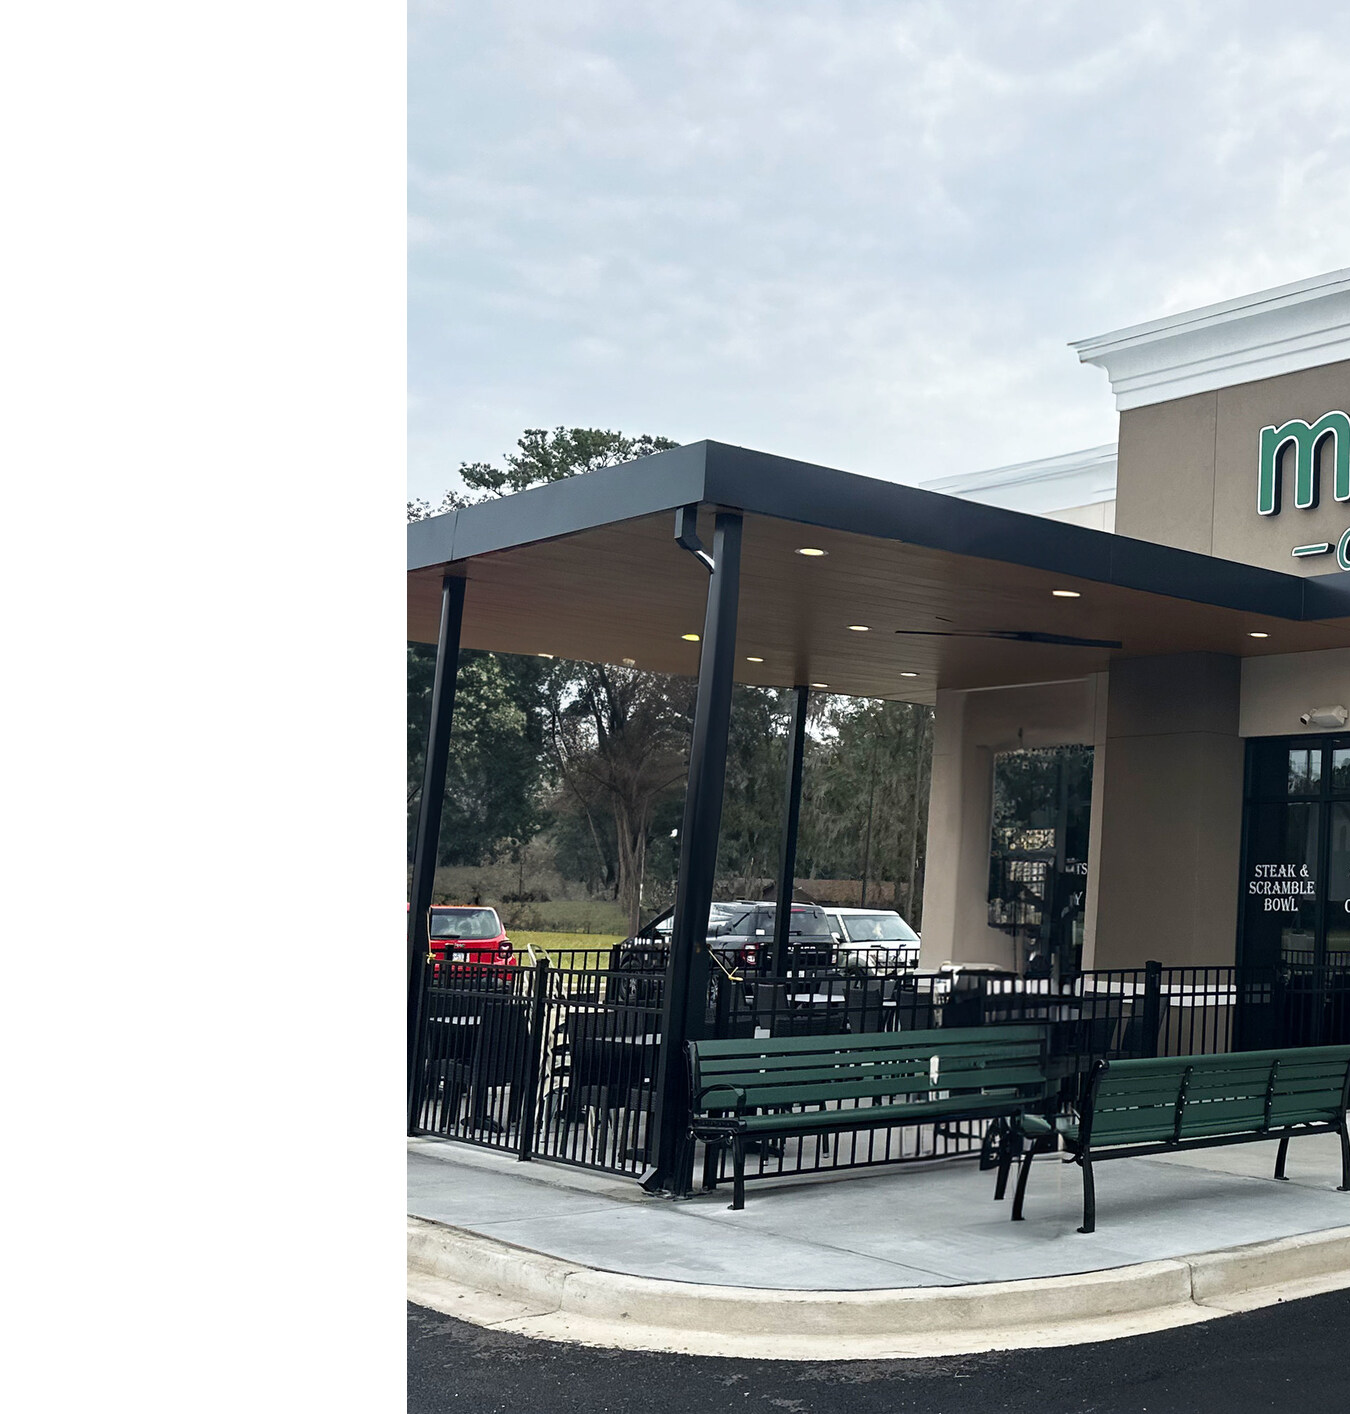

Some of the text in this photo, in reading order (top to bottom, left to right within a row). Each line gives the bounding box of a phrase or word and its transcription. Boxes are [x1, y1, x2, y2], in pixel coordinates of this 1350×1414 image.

[1254, 864, 1310, 878] STEAK &
[1249, 881, 1316, 895] SCRAMBLE
[1263, 895, 1299, 912] BOWL
